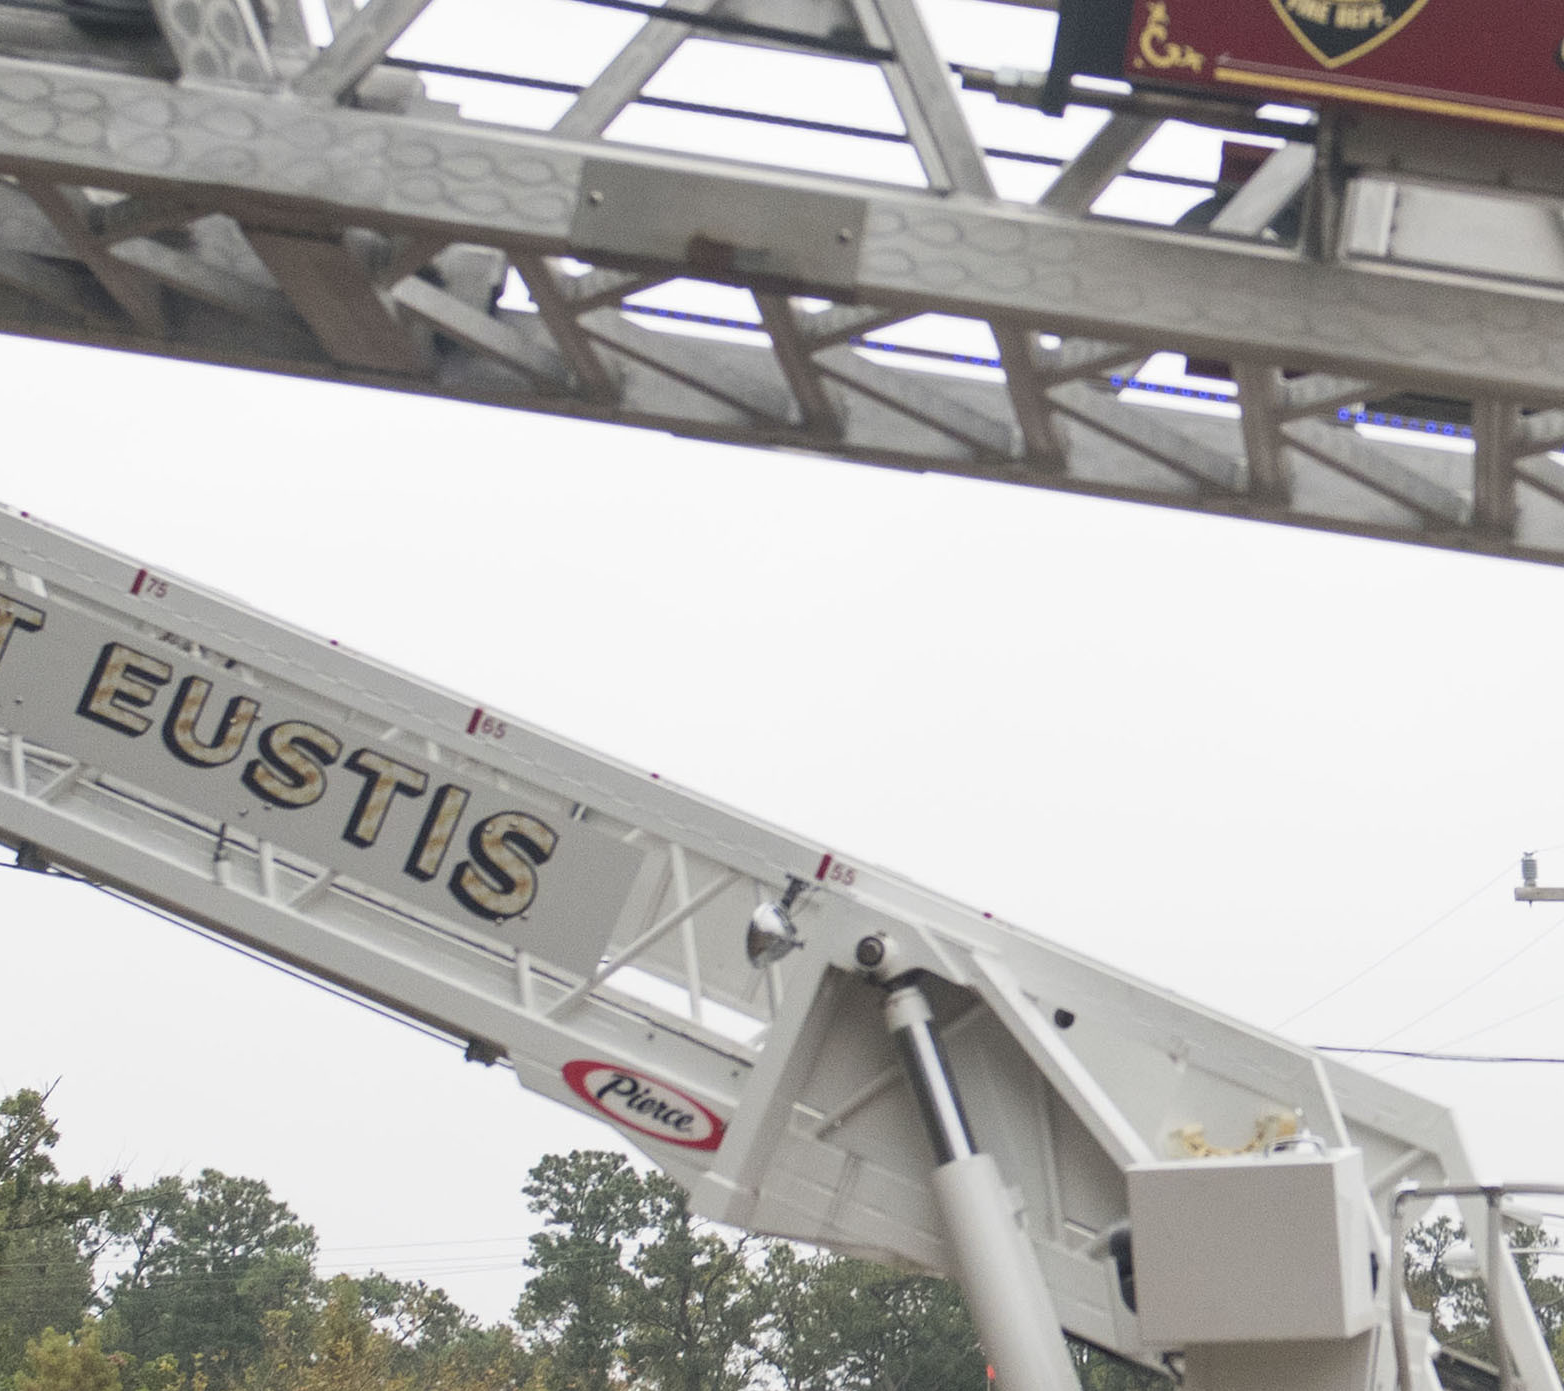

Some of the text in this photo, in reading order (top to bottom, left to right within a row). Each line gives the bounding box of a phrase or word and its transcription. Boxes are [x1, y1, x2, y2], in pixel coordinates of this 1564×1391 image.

[146, 577, 169, 599] 75
[481, 717, 507, 740] 65
[77, 640, 561, 924] EUSTIS
[830, 863, 858, 887] 55
[595, 1071, 696, 1135] Pierce
